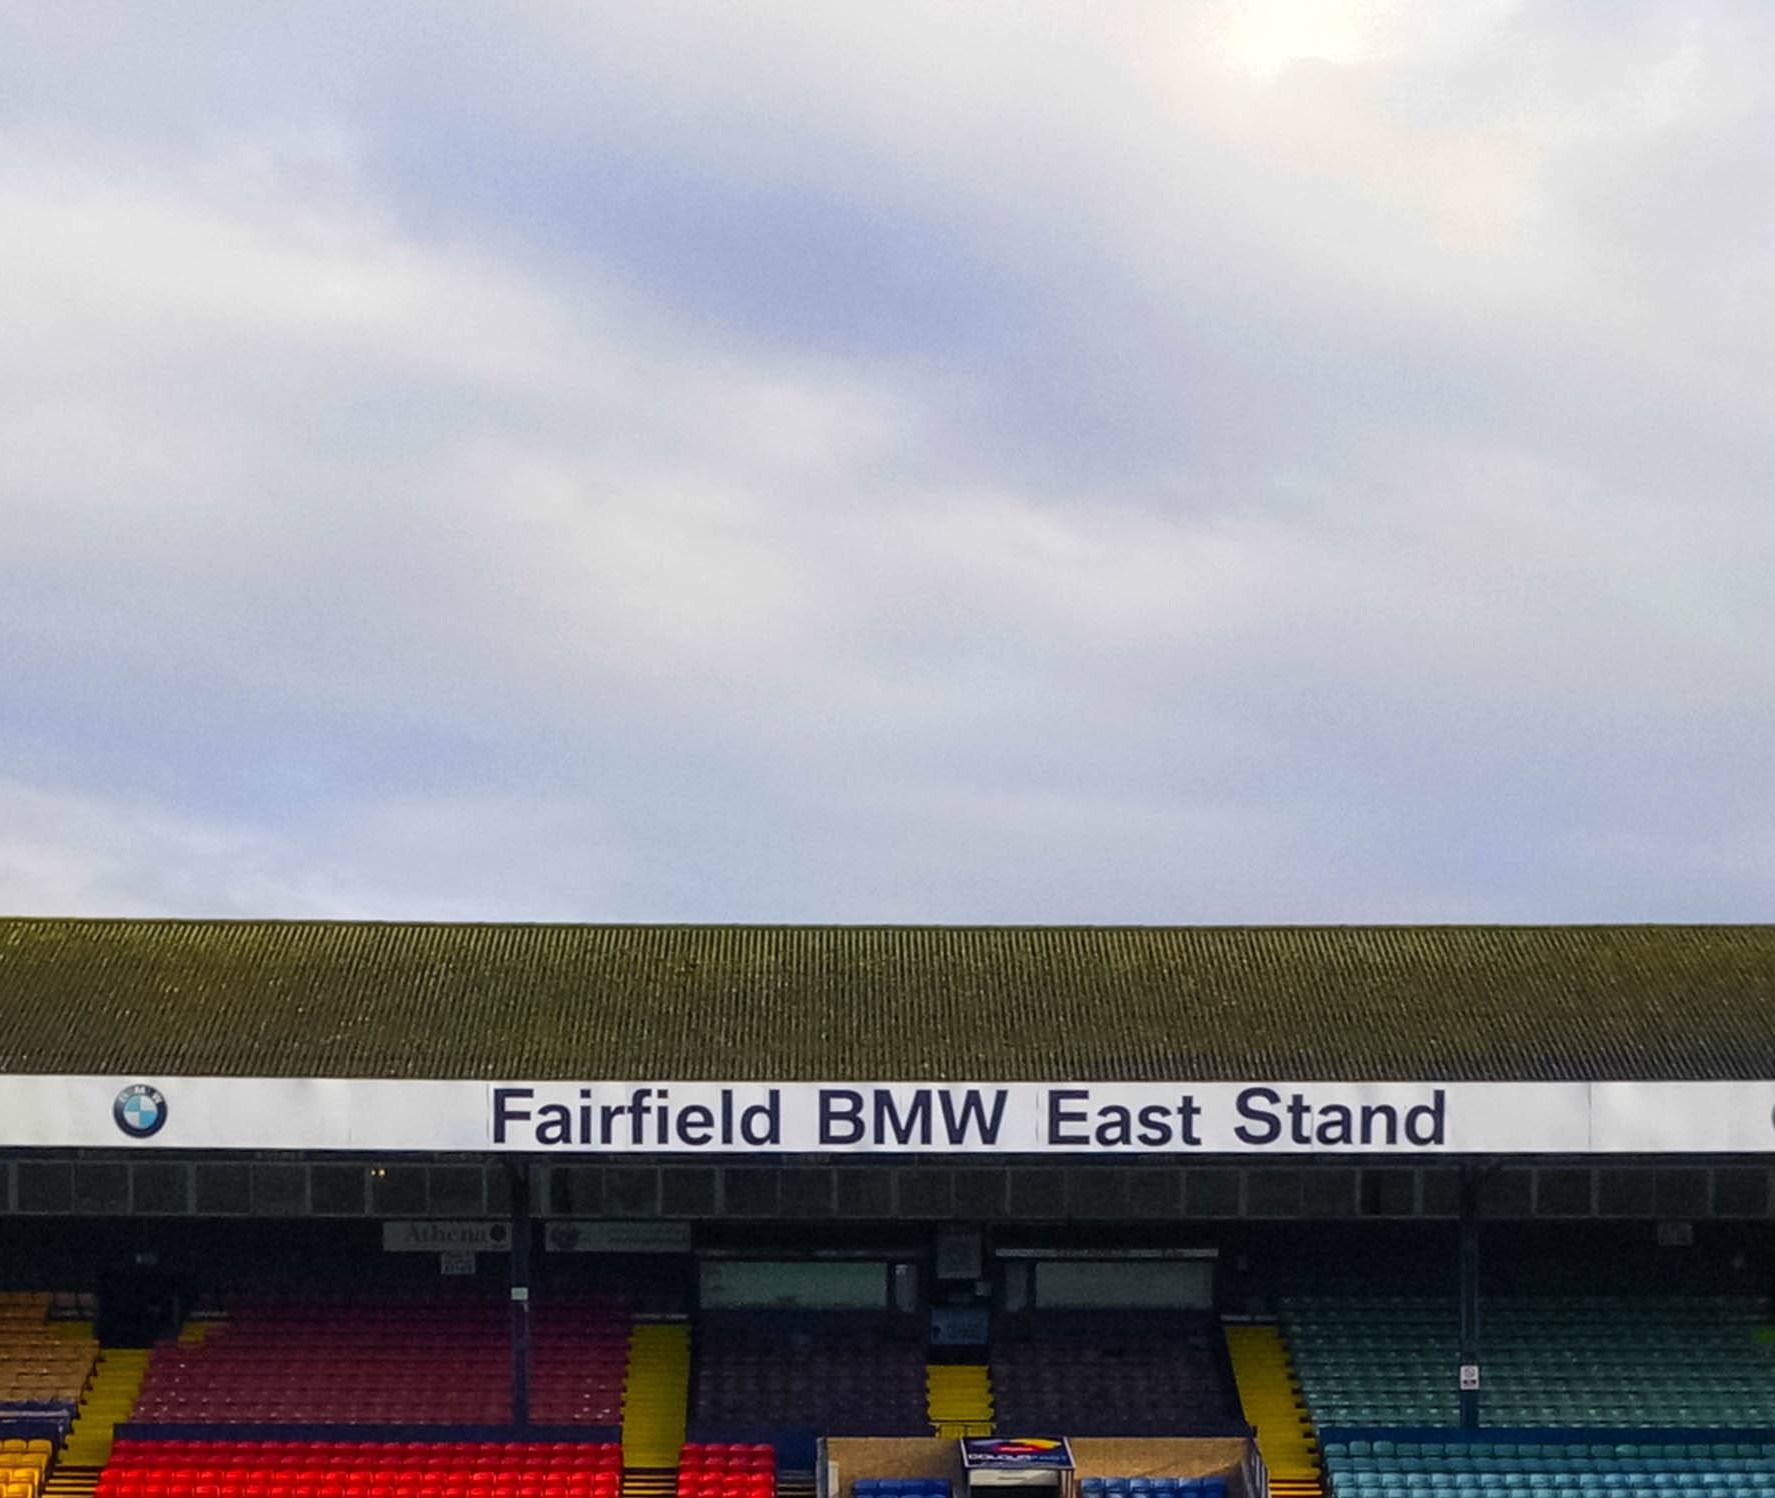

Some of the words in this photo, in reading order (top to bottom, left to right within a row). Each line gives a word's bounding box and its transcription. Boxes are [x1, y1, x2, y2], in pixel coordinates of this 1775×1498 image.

[492, 1088, 781, 1146] Fairfield
[817, 1089, 1009, 1146] BMW
[1047, 1089, 1203, 1147] East
[1233, 1087, 1445, 1147] Stand
